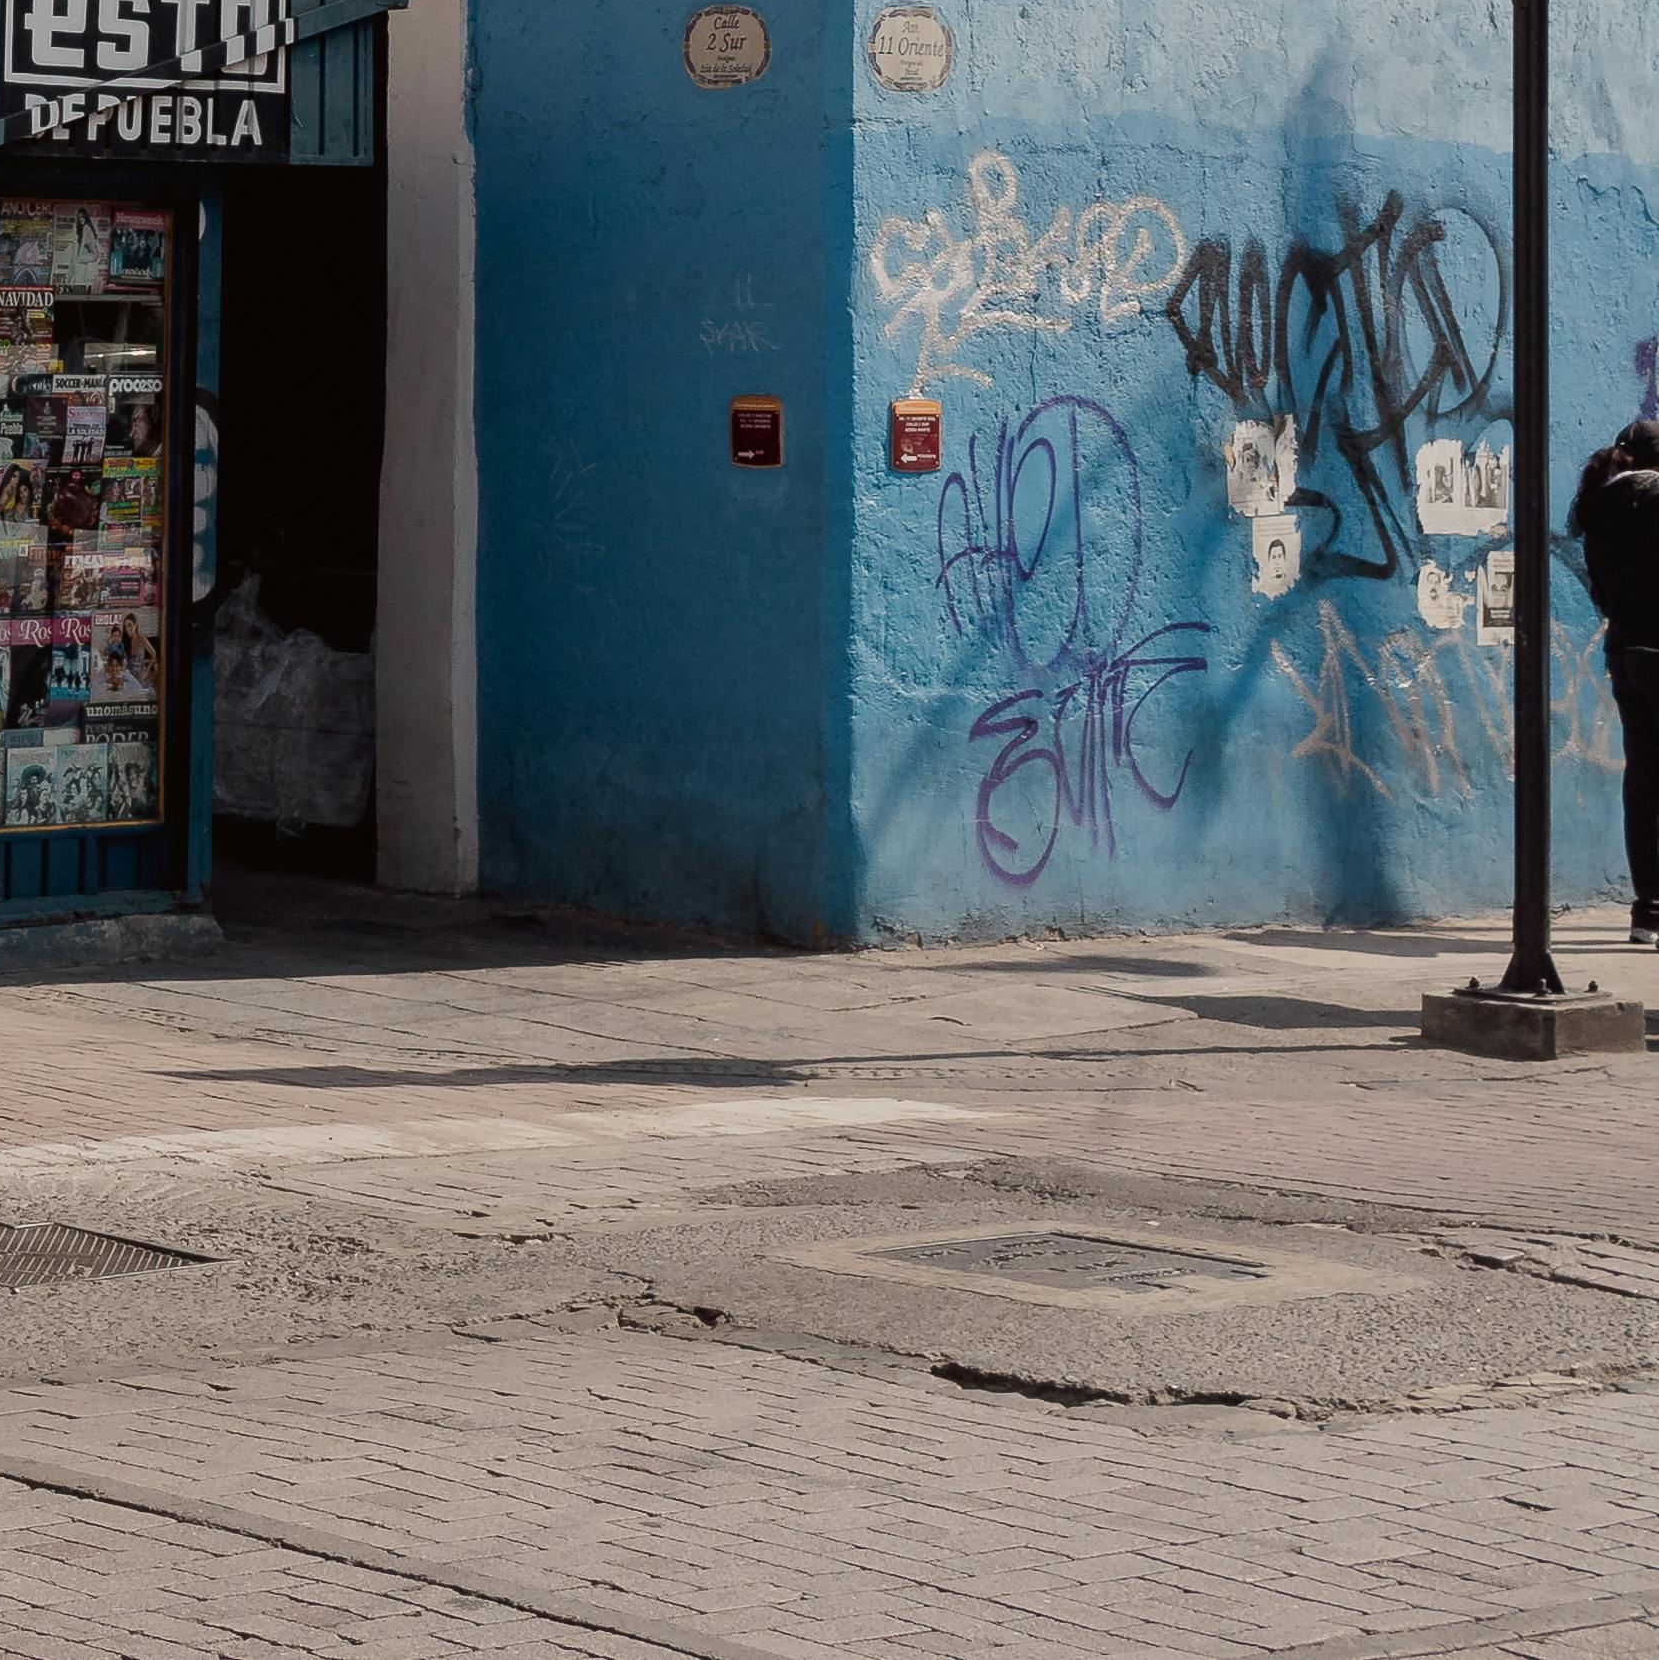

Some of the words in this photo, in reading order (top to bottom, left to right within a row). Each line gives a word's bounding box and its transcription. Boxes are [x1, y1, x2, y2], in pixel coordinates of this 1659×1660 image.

[714, 14, 740, 30] Calle
[706, 32, 717, 51] 2
[719, 32, 748, 53] Sur
[878, 35, 893, 55] 11
[898, 36, 944, 57] Oriente
[25, 93, 85, 151] DE
[87, 94, 263, 156] PUEBLA
[108, 377, 164, 395] proceso
